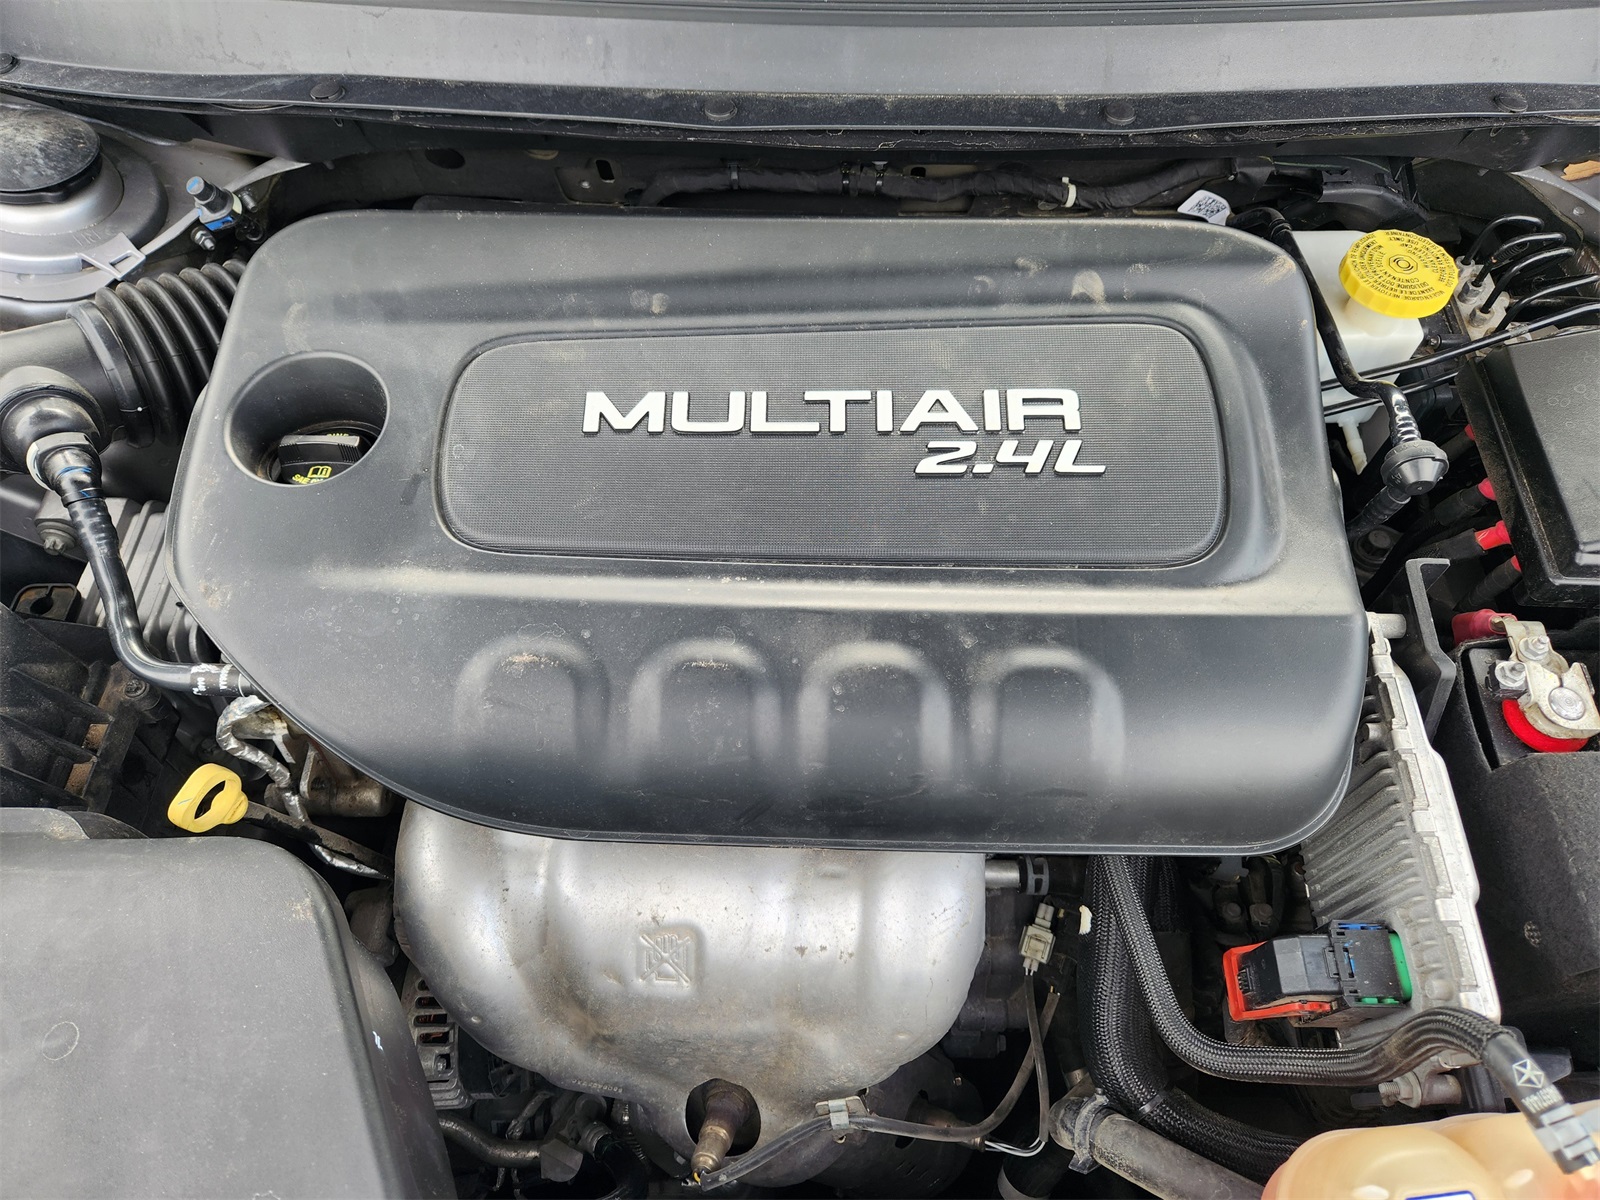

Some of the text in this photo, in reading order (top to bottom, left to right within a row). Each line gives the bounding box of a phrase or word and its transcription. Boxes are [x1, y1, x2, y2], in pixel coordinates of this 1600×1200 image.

[1369, 284, 1400, 298] NETTOYER
[582, 388, 1082, 435] MULTIAIR
[914, 438, 1108, 475] 2.4L
